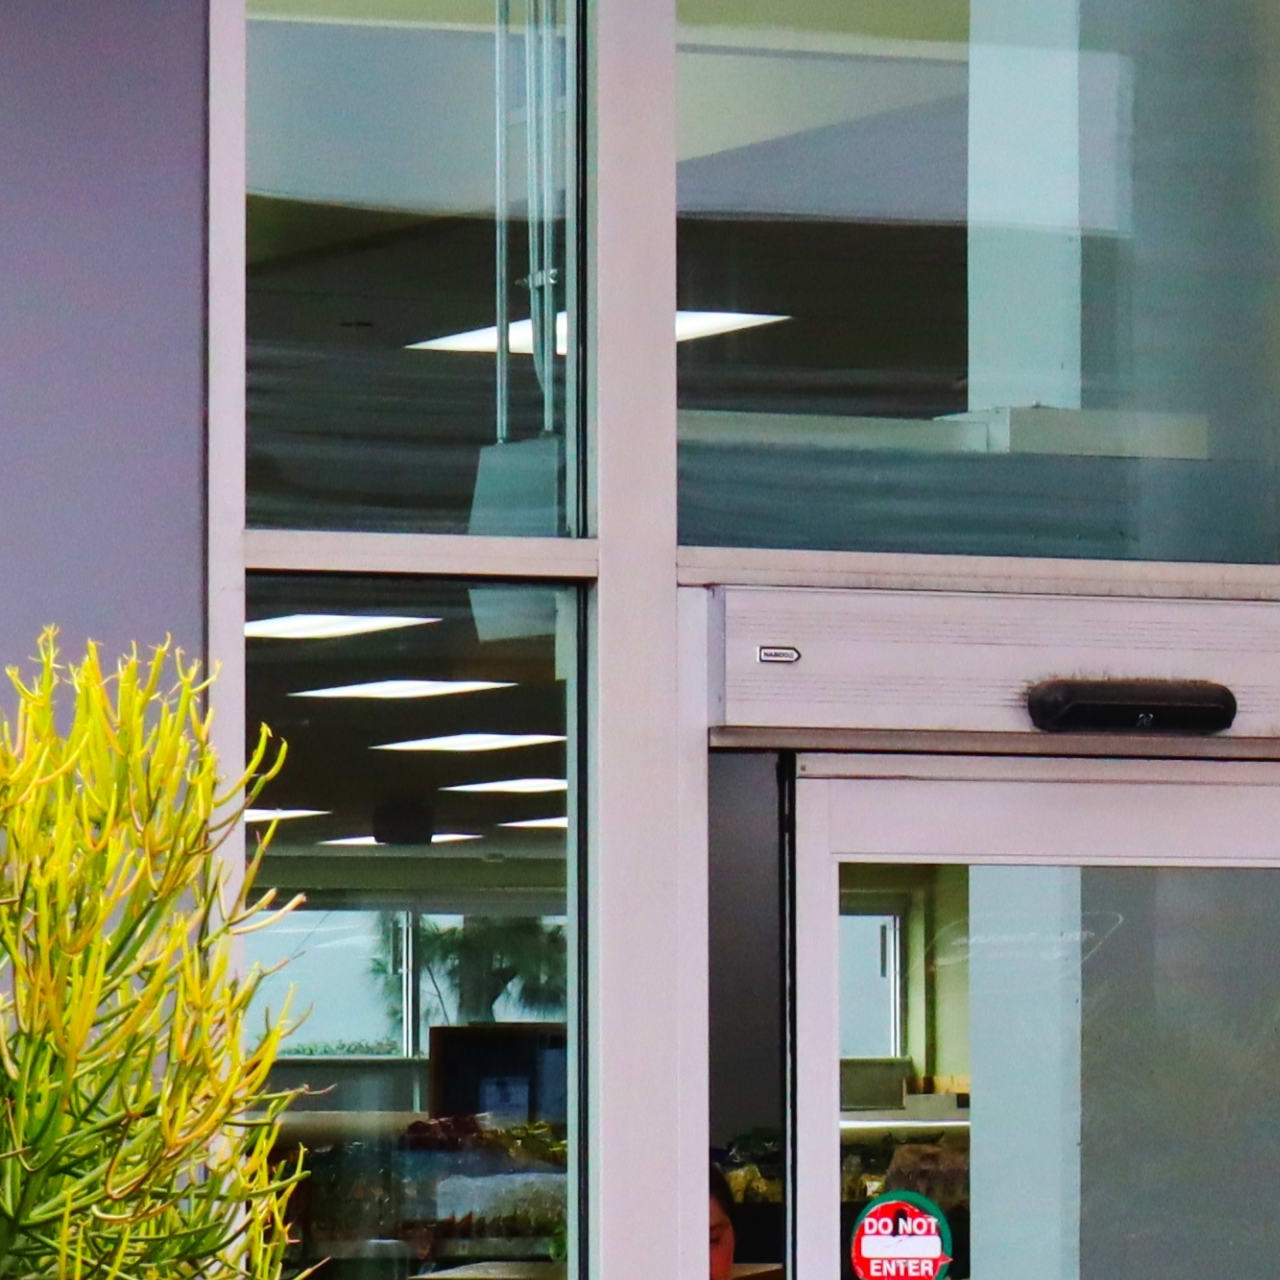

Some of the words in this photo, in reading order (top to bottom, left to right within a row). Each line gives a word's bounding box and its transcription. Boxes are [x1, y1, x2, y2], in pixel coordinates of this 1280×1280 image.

[864, 1217, 894, 1234] DO
[898, 1217, 939, 1234] NOT
[869, 1259, 934, 1276] ENTER
